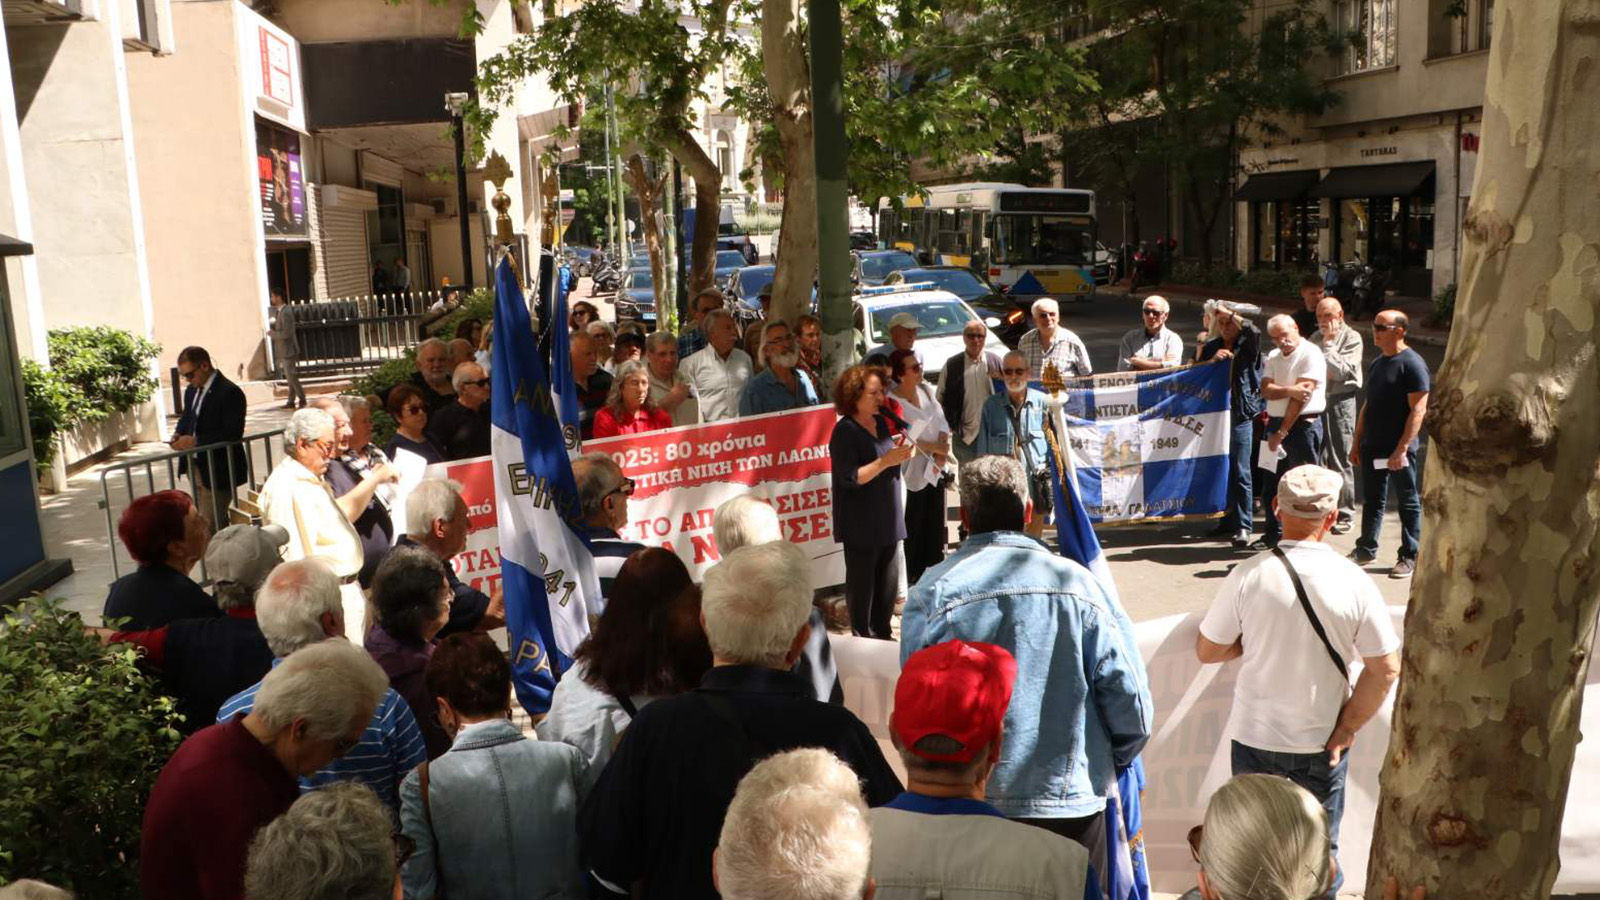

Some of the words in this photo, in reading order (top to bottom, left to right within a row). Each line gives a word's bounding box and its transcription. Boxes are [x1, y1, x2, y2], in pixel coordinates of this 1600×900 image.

[665, 441, 693, 462] 80
[697, 433, 767, 459] χρόνια
[687, 460, 732, 481] ΝΙΚΗ
[736, 453, 773, 472] ΤΩΝ
[777, 444, 832, 466] ΛΑΩΝ!
[635, 516, 671, 540] ΤΟ
